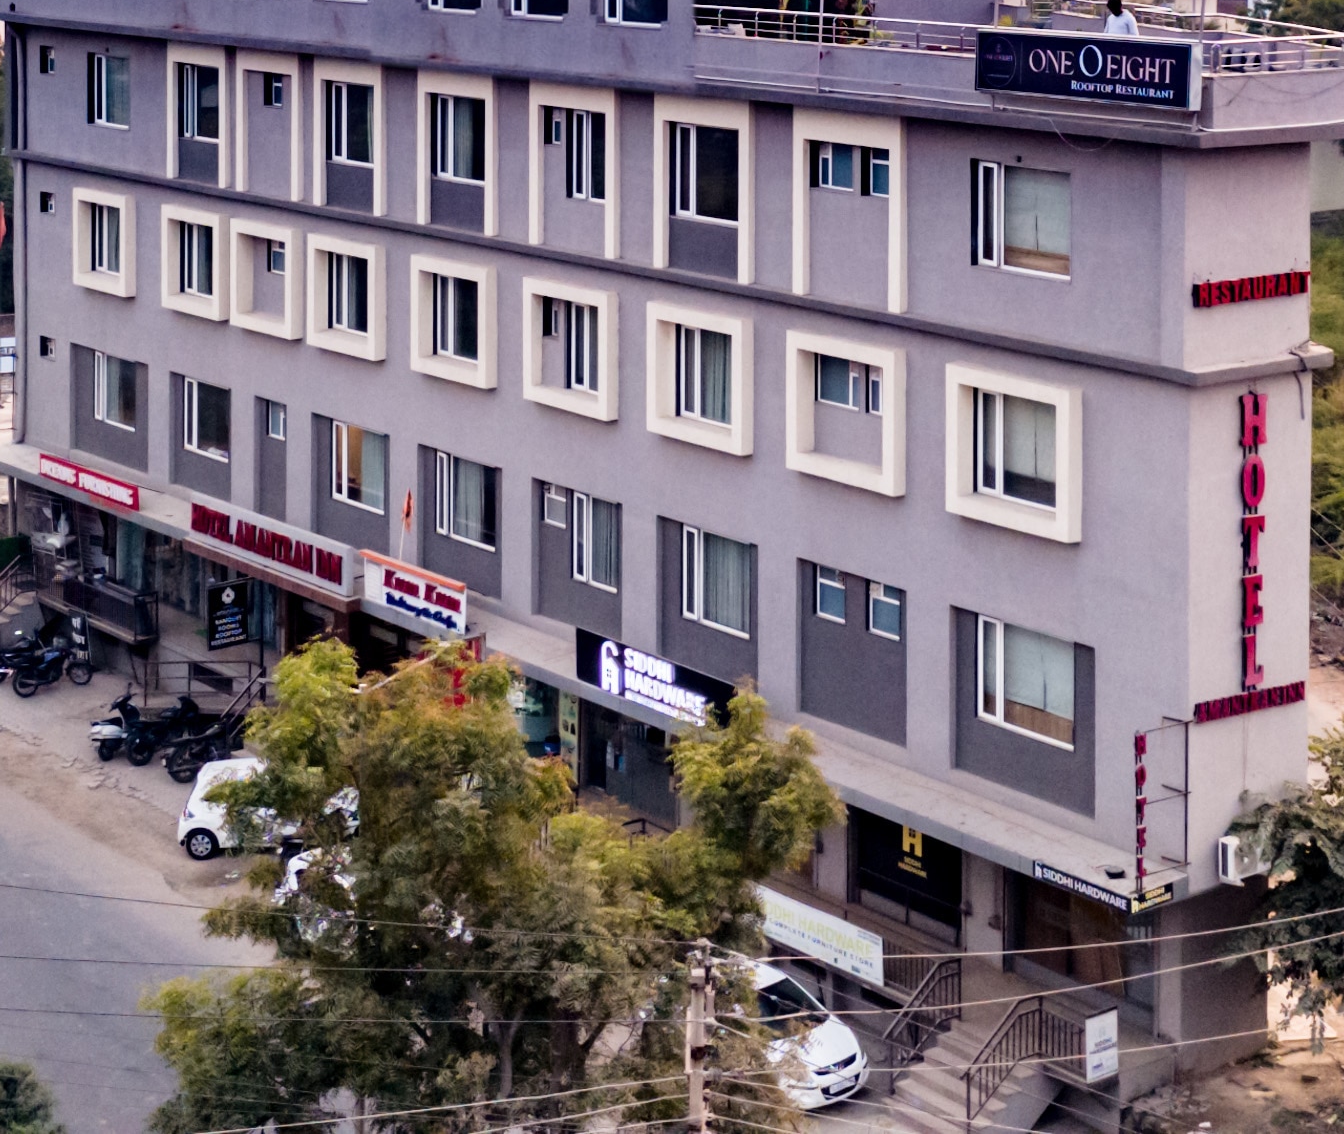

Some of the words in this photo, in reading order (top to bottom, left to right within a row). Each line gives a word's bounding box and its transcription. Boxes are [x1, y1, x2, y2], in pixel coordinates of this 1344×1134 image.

[1029, 48, 1074, 76] ONE
[1079, 44, 1103, 77] O
[1106, 54, 1176, 84] EIGHT
[1071, 80, 1114, 94] ROOFTOP
[1115, 83, 1175, 100] RESTAURANT
[1193, 271, 1311, 307] RESTAURANT
[191, 502, 233, 544] HOTEL
[1239, 393, 1268, 689] HOTEL
[624, 647, 676, 684] SIDDHI
[625, 669, 707, 717] HARDWARE
[1043, 867, 1074, 889] SIDDHI
[1074, 880, 1128, 911] HARDWARE
[765, 901, 795, 924] DDHI
[799, 914, 873, 958] HARDWARE
